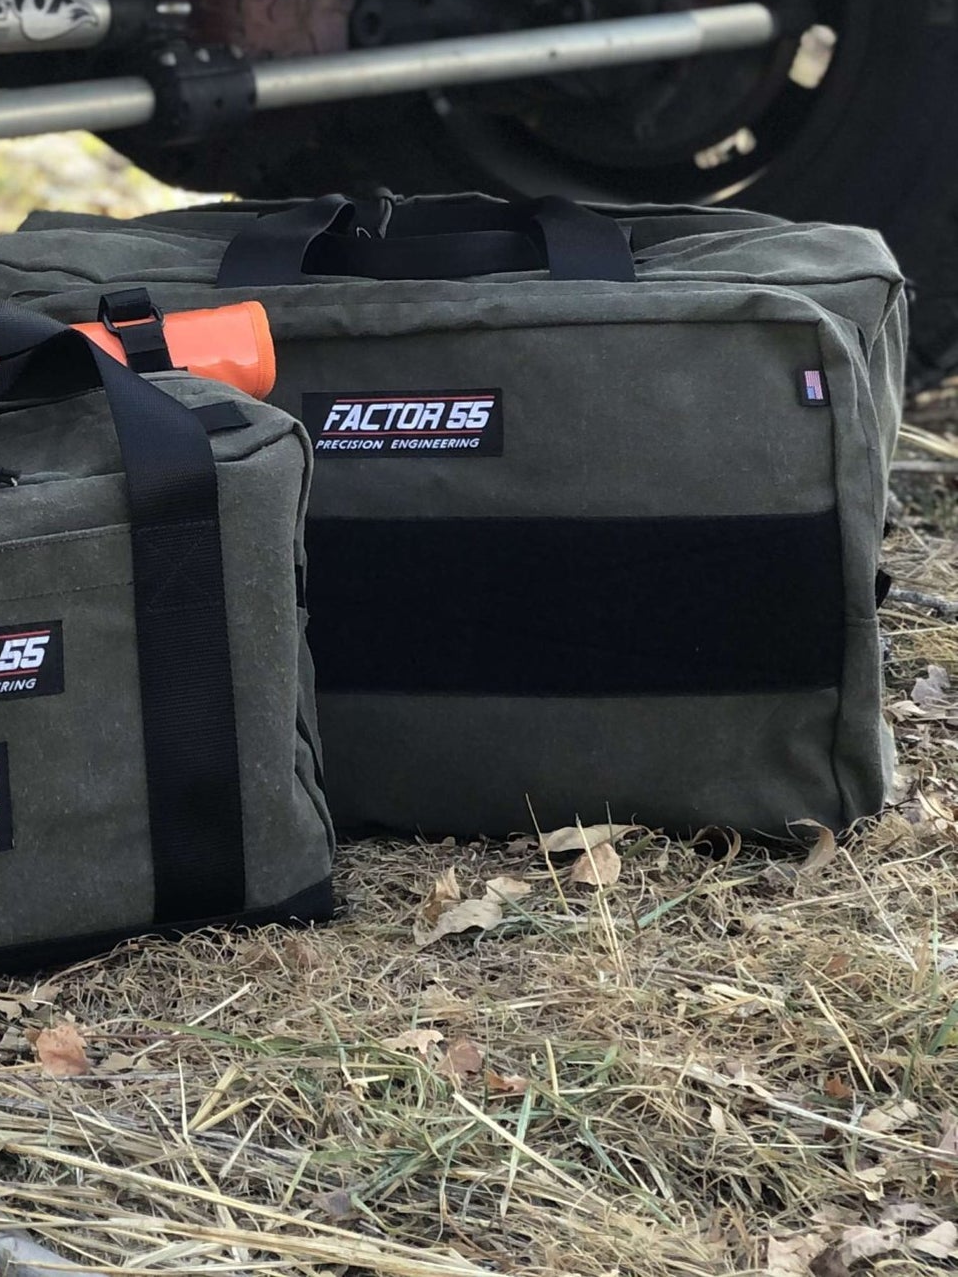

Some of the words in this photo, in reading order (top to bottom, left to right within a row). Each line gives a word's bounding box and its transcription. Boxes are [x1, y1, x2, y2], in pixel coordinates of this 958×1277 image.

[323, 402, 446, 431] FACTOR
[446, 401, 495, 430] 55
[315, 439, 384, 450] PRECISION
[390, 438, 481, 450] ENGINEERING
